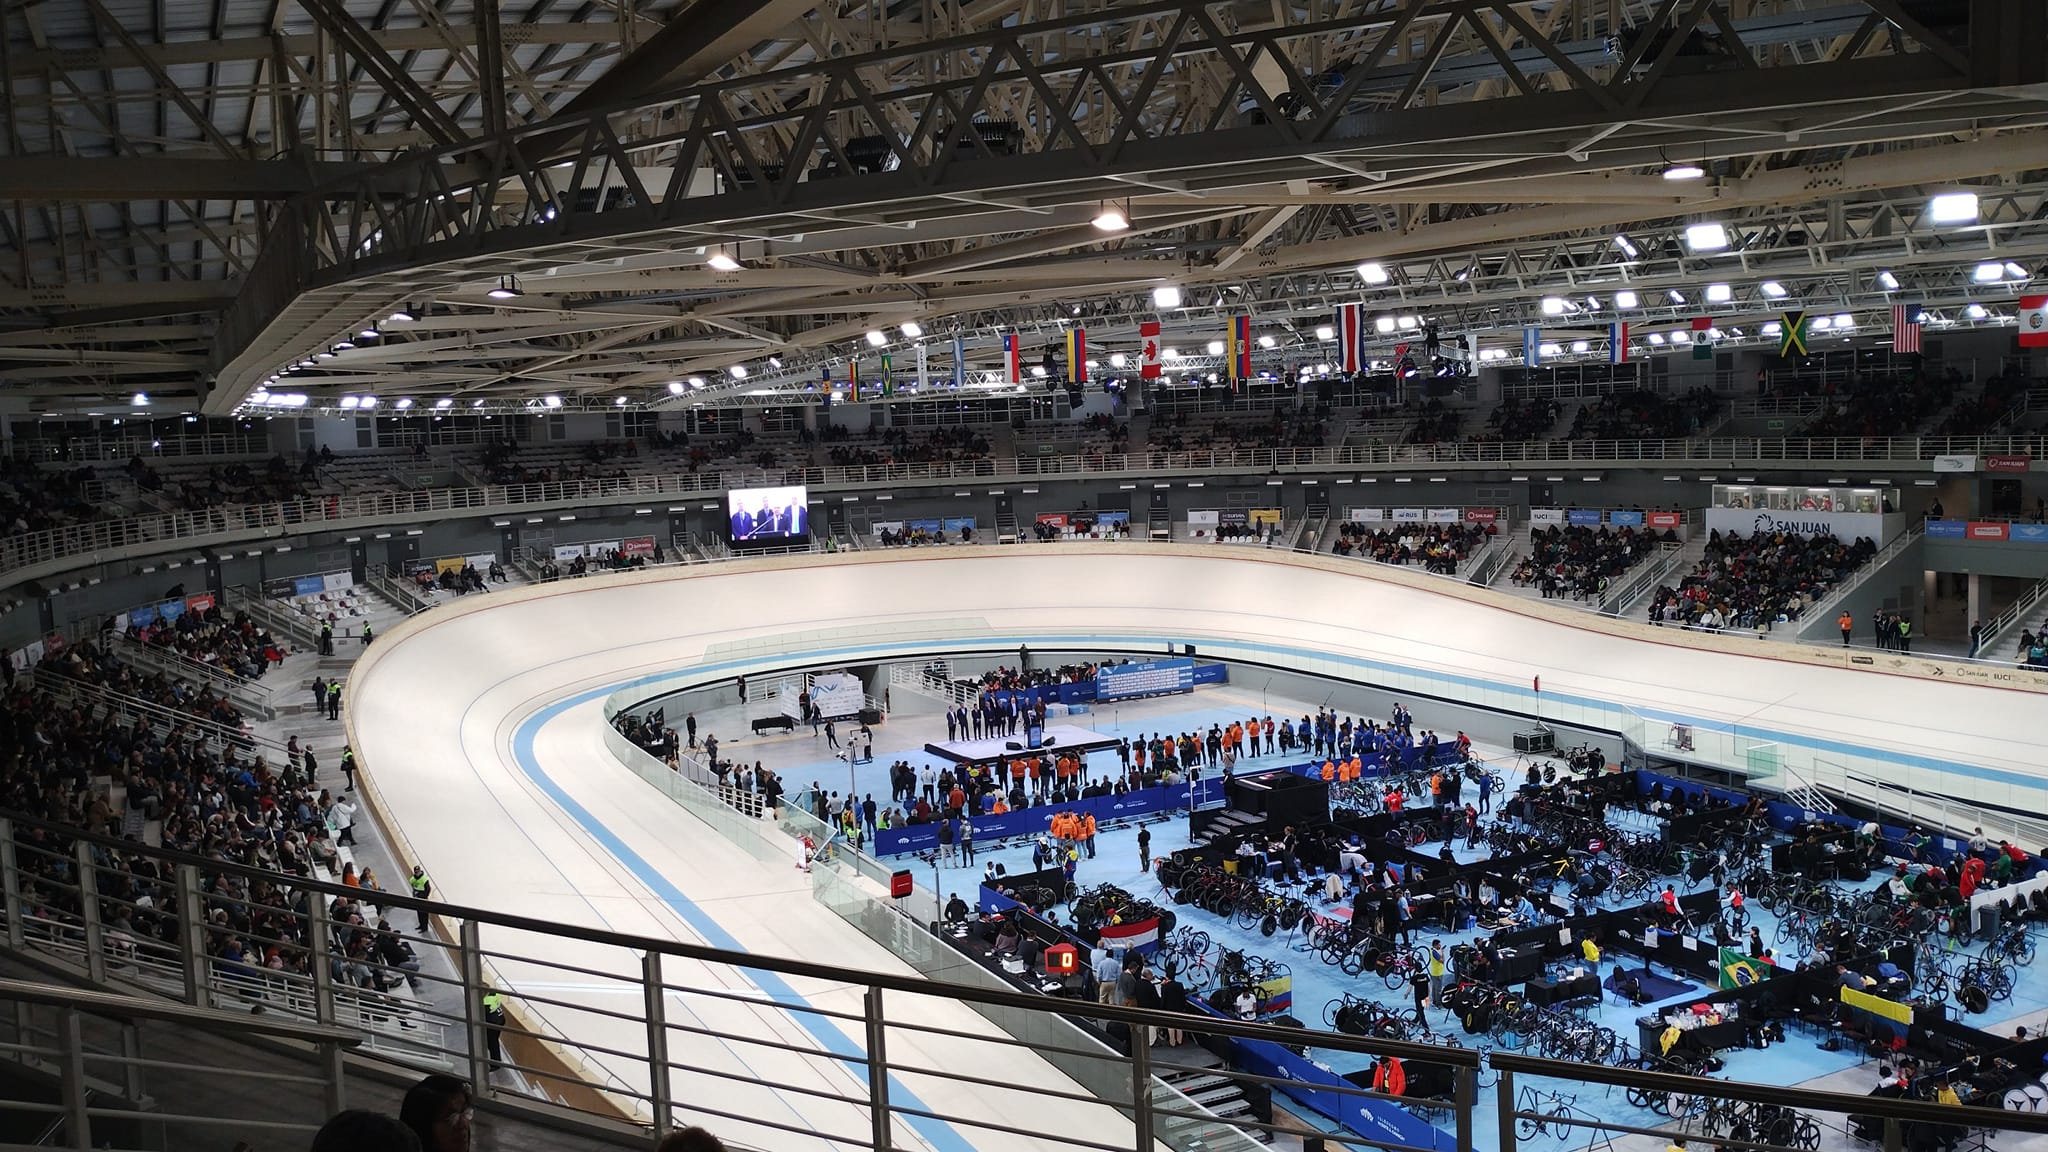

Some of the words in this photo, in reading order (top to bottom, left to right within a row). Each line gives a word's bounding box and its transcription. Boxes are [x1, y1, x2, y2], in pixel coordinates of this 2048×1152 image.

[1776, 520, 1799, 532] SAN
[1801, 522, 1830, 534] JUAN
[1996, 673, 2011, 681] UCI
[1062, 952, 1073, 968] 0
